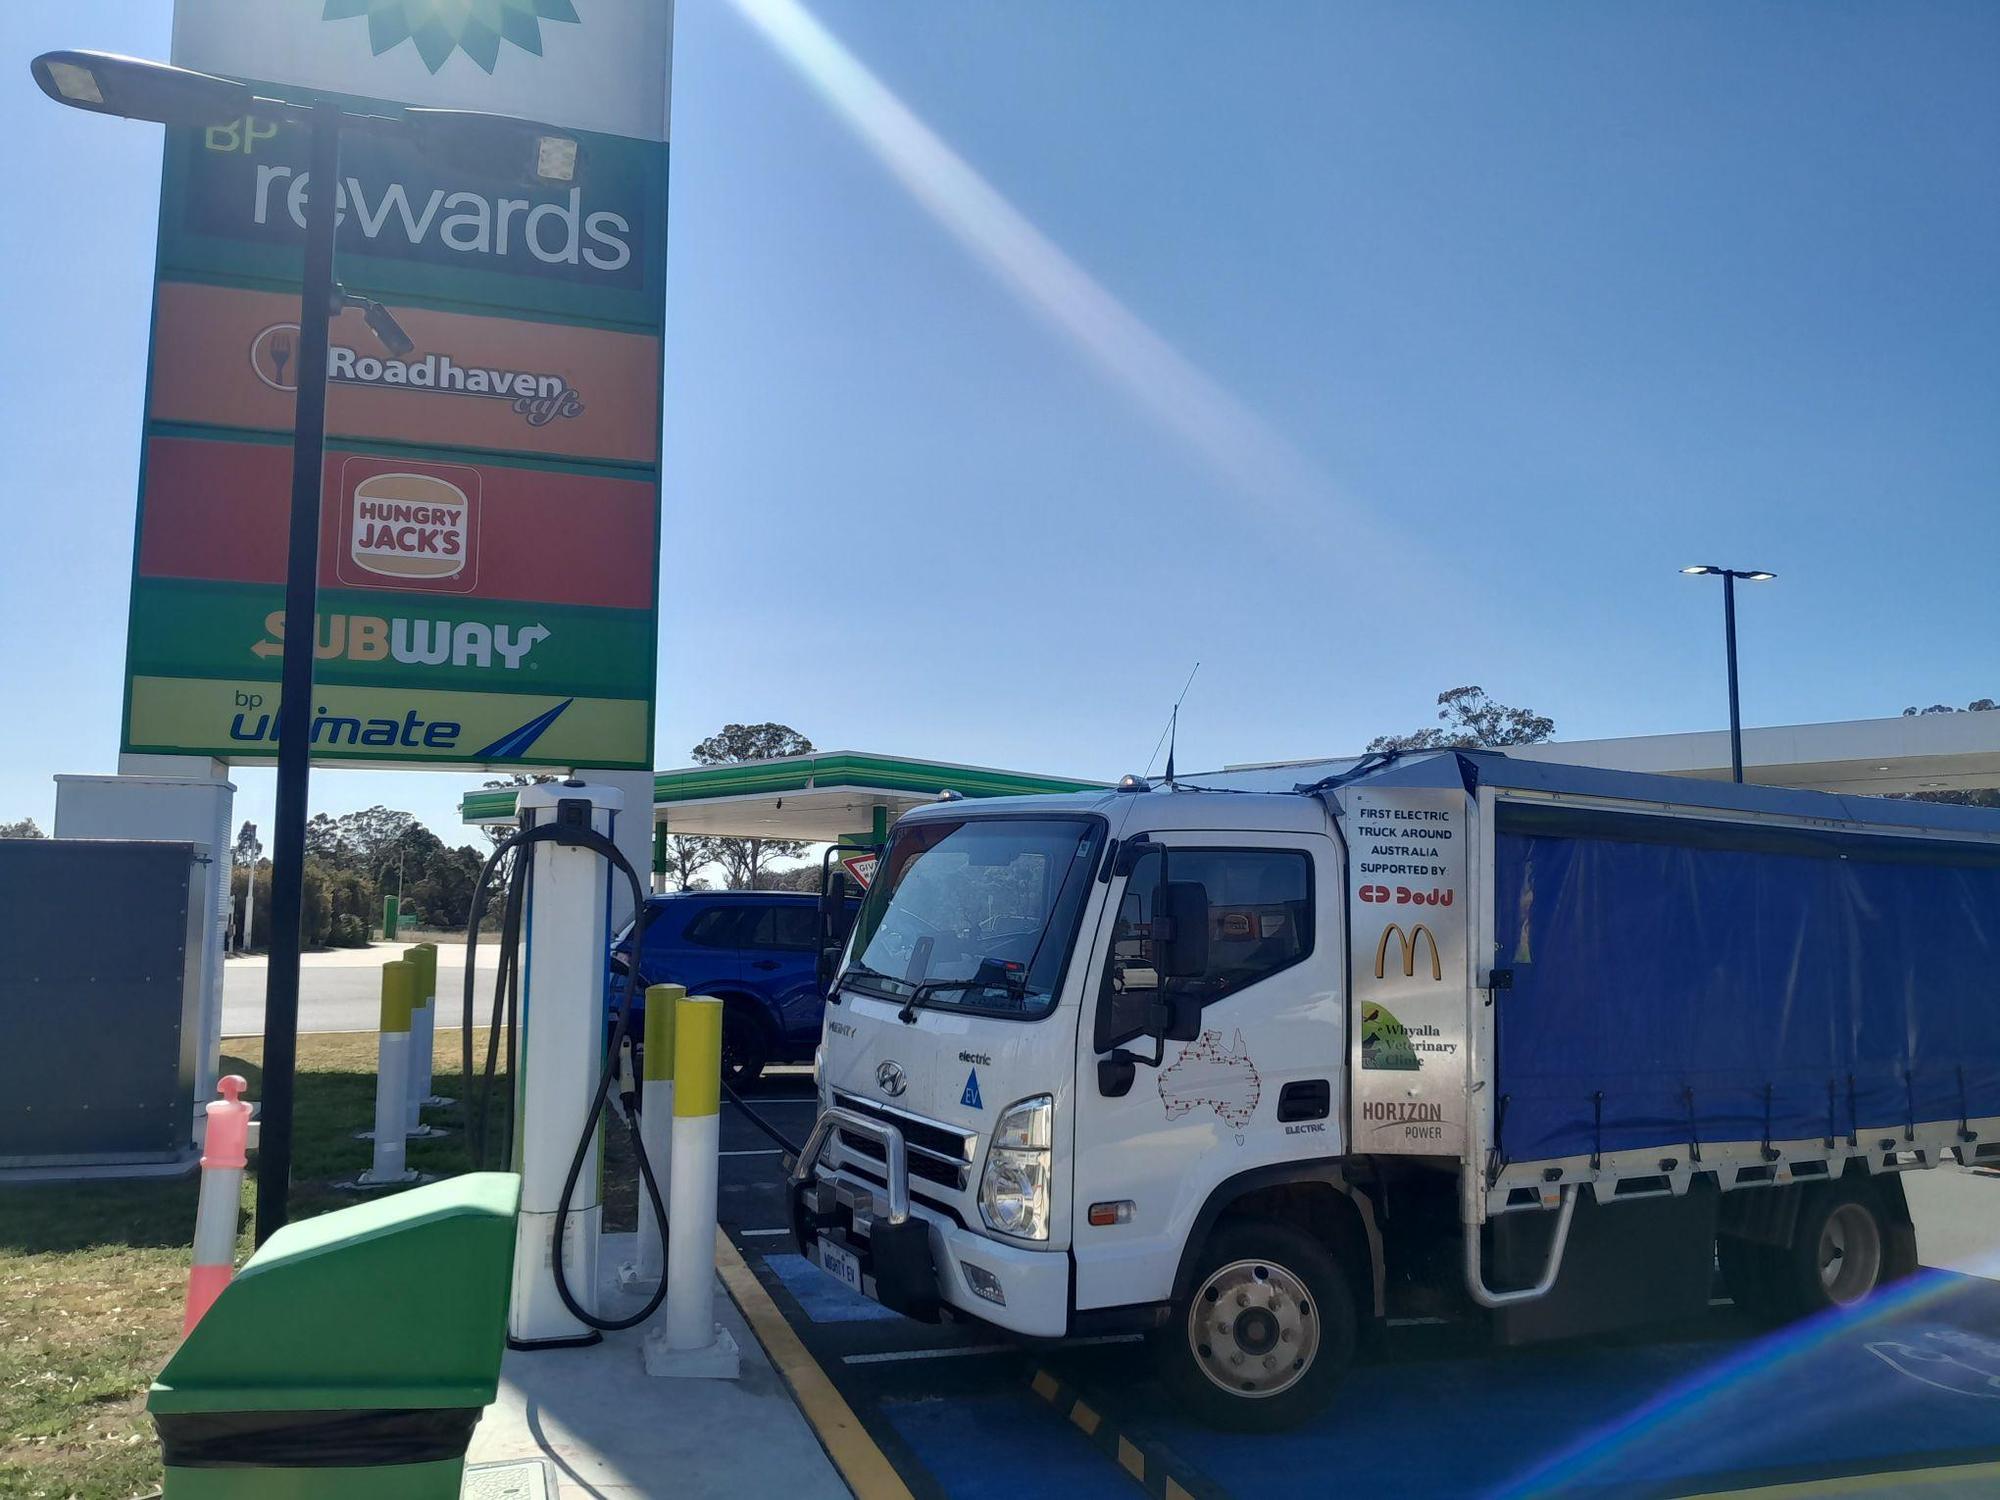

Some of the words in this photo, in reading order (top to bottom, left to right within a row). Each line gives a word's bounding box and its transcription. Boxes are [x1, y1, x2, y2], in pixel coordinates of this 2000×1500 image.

[254, 164, 632, 272] rewards
[328, 347, 562, 398] Roadhaven
[359, 501, 462, 527] HUNGRY
[358, 523, 461, 555] JACK'S
[251, 610, 552, 669] SUBWAY
[235, 690, 263, 711] bp
[229, 705, 461, 748] ulimate
[1360, 808, 1392, 819] FIRST
[1394, 810, 1449, 822] ELECTRIC
[1358, 826, 1397, 838] TRUCK
[1401, 829, 1452, 840] AROUND
[1371, 845, 1439, 857] AUSTRALIA
[1360, 862, 1429, 875] SUPPORTED
[1396, 886, 1454, 907] Dodd
[1386, 1024, 1441, 1038] Whyalla
[1386, 1040, 1457, 1054] Veterinary
[958, 1049, 992, 1066] electric
[965, 1087, 978, 1105] EV
[1363, 1101, 1442, 1122] HORIZON
[1285, 1123, 1326, 1135] ELECTRIC
[1405, 1126, 1442, 1139] POWER
